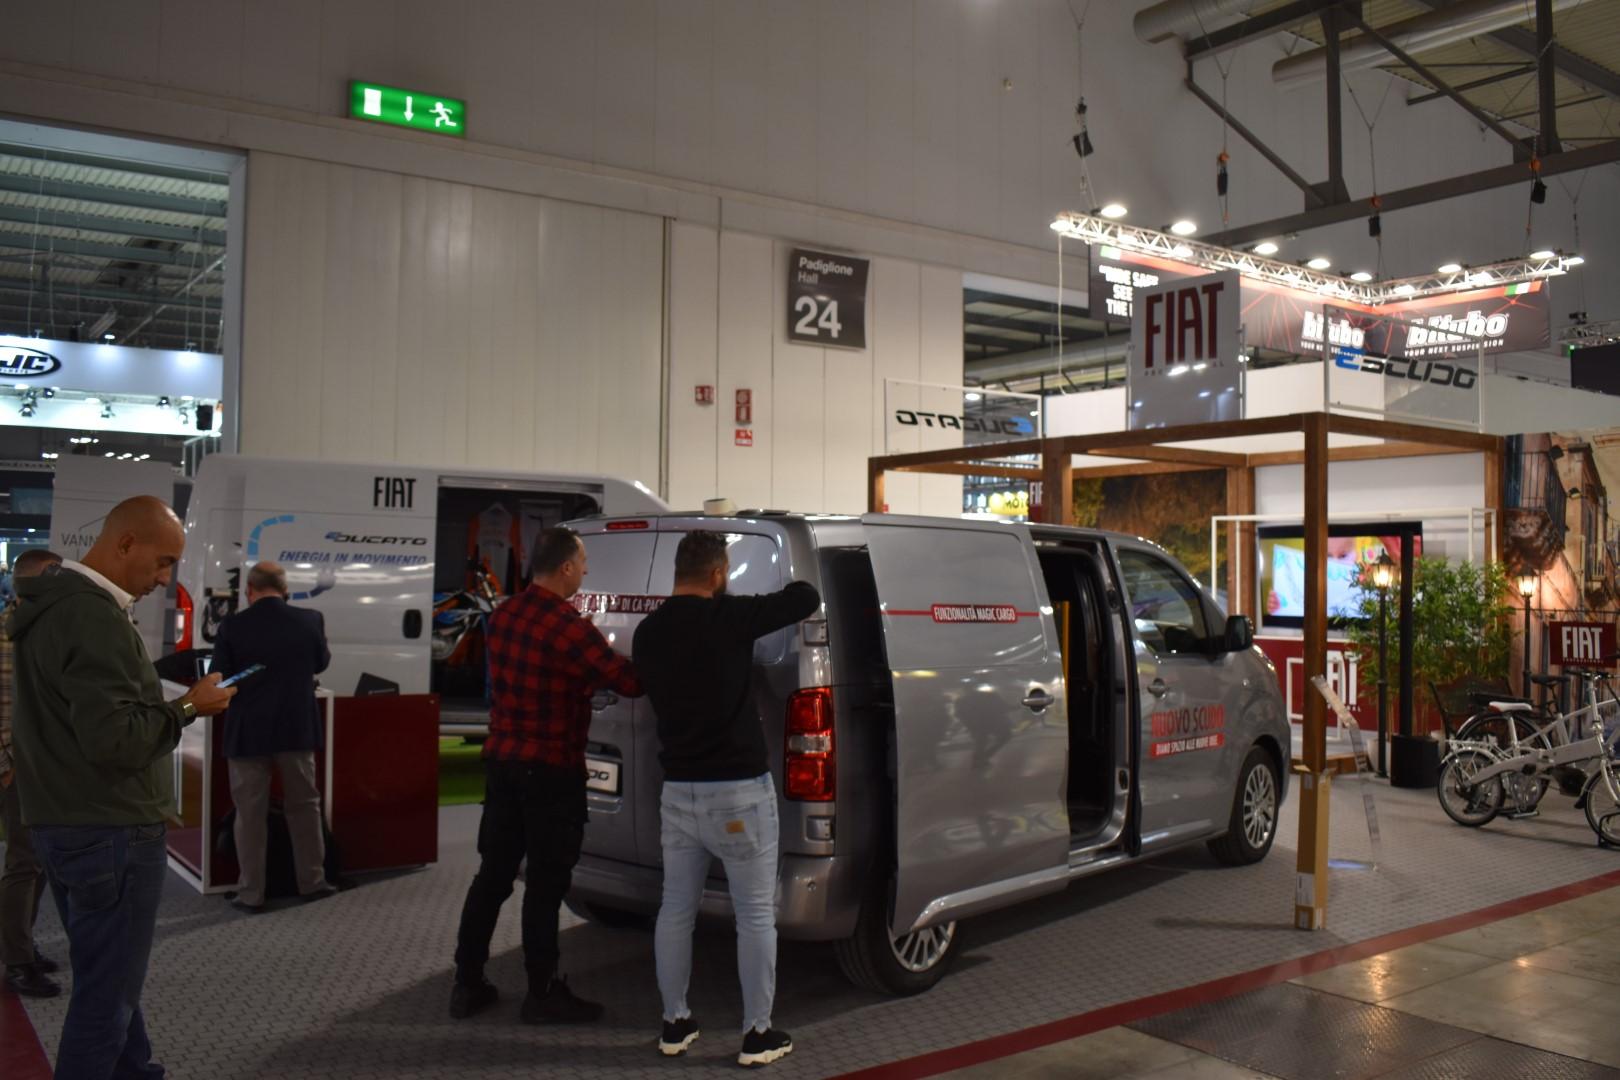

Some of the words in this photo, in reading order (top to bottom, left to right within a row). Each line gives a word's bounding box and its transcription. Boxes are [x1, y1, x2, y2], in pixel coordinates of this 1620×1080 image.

[799, 256, 854, 276] Padiglione
[798, 271, 818, 284] Hall
[794, 295, 842, 338] 24
[1145, 281, 1224, 369] FIAT
[1404, 348, 1425, 357] YOUR
[1428, 345, 1448, 354] NEXT
[0, 354, 49, 370] JC
[373, 476, 416, 508] FIAT
[61, 533, 97, 546] VANN
[278, 550, 331, 562] ENERGIA
[335, 552, 350, 562] IN
[352, 553, 427, 565] MOVIMENTO
[977, 607, 997, 621] MAGIC
[996, 607, 1016, 621] CARGO
[1562, 626, 1603, 659] FIAT
[1326, 650, 1362, 706] AT
[1152, 708, 1190, 738] NUOVO
[1193, 704, 1224, 732] SCUDO
